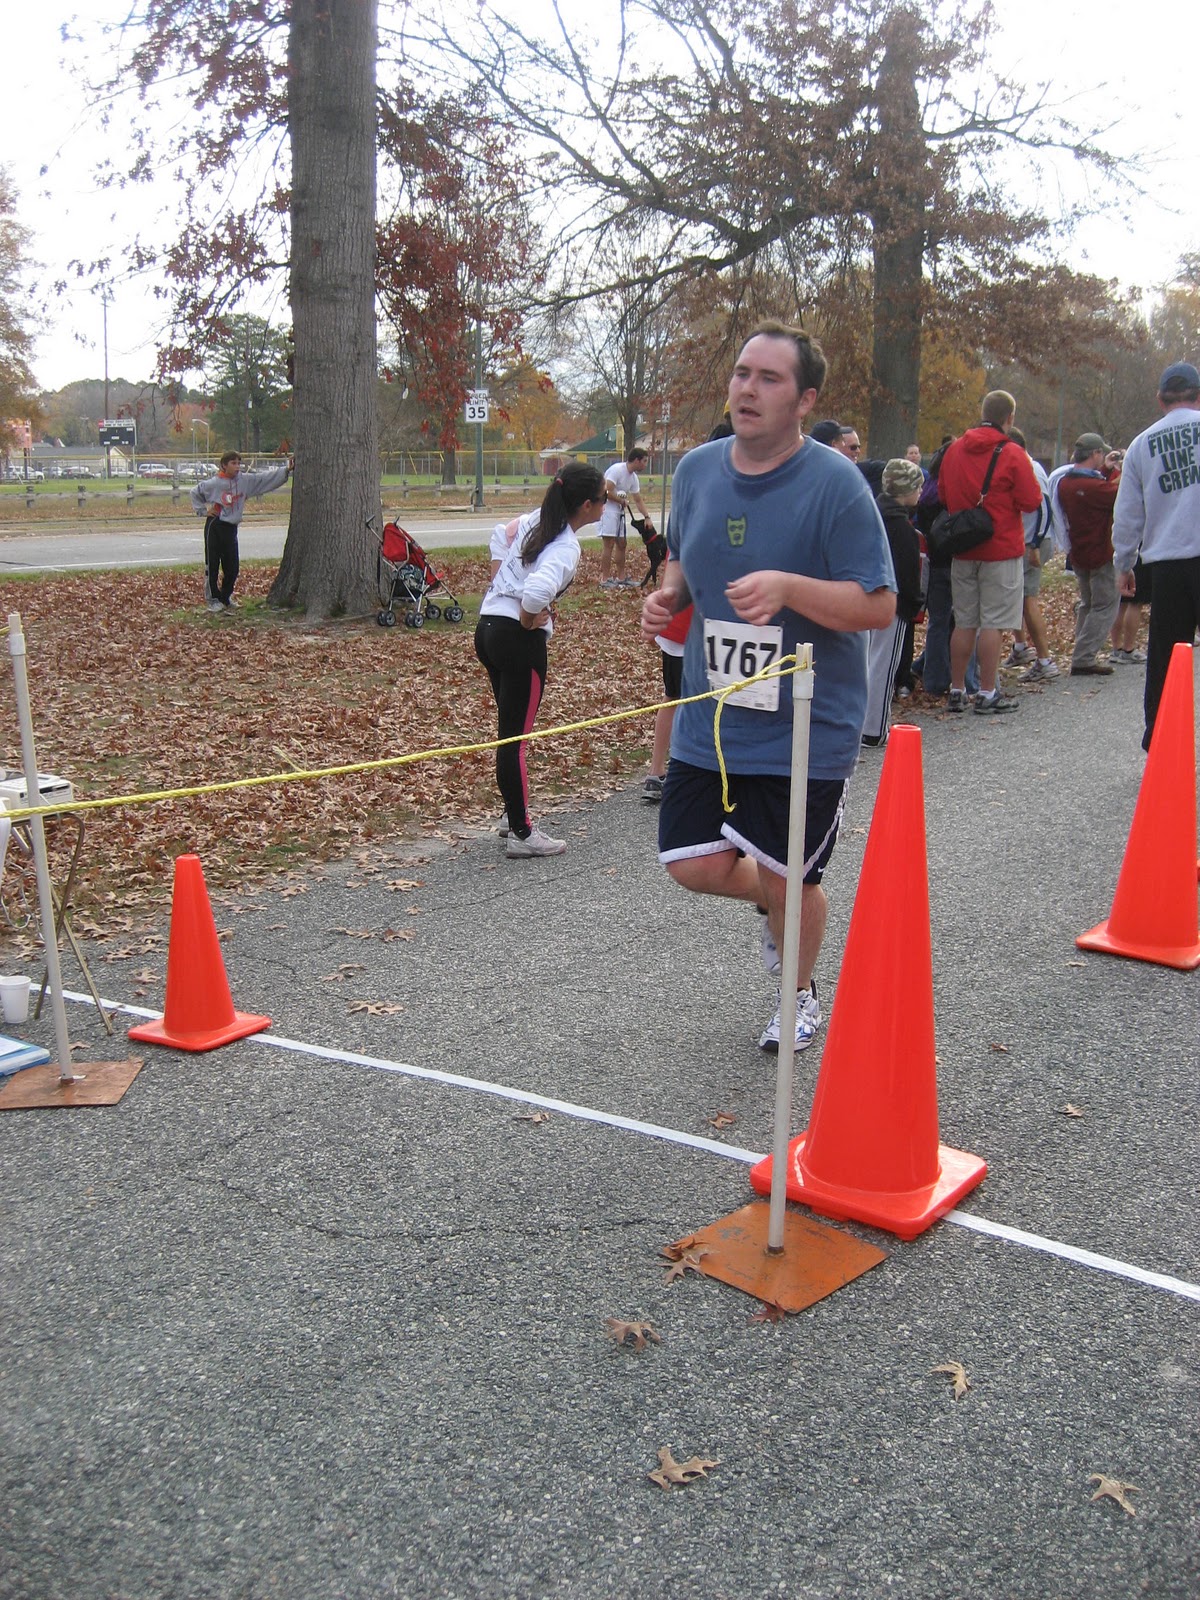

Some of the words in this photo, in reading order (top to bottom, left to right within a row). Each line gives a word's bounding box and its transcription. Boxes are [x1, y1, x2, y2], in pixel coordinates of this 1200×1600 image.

[468, 406, 486, 419] 35
[1173, 422, 1191, 431] TRACK
[1161, 445, 1196, 473] LINE
[1158, 464, 1200, 494] CREW
[706, 635, 778, 678] 1767
